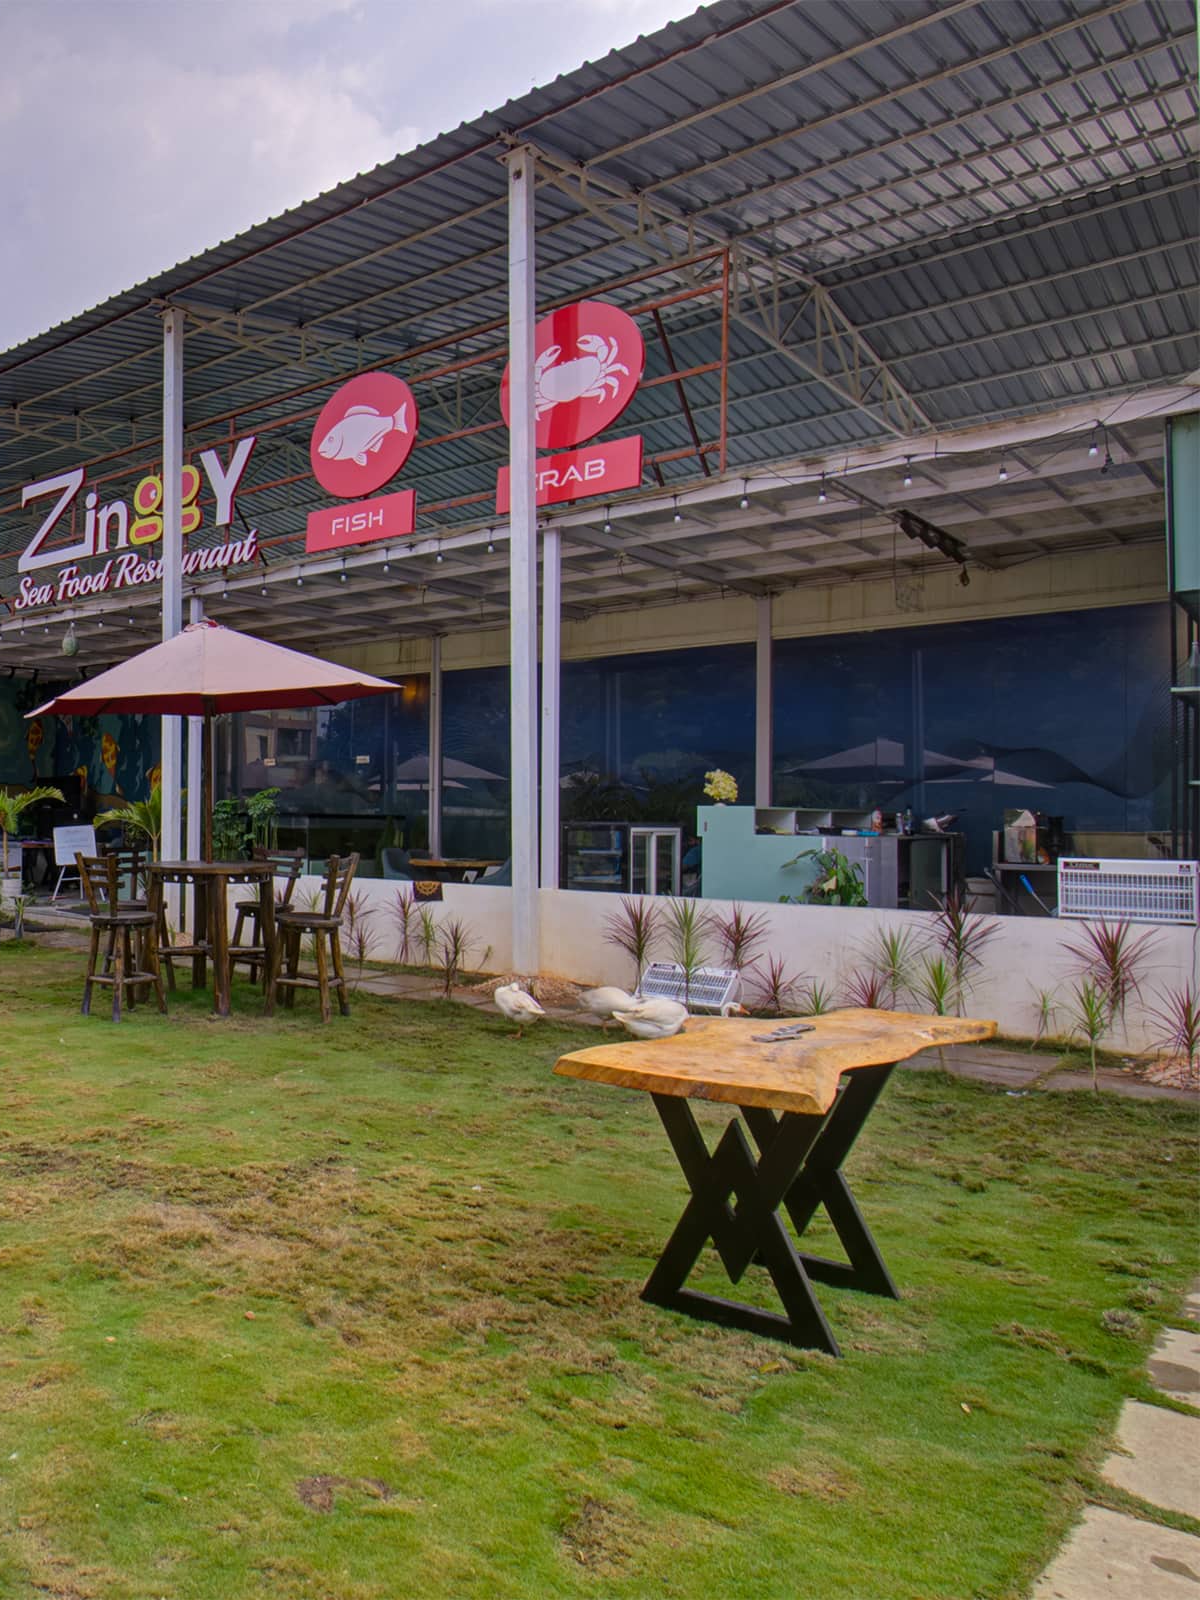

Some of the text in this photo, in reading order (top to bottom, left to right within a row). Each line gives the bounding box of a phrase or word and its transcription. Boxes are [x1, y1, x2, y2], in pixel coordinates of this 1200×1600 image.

[535, 459, 606, 491] RAB
[331, 508, 384, 536] FISH
[14, 528, 259, 609] Sea Food Resurant
